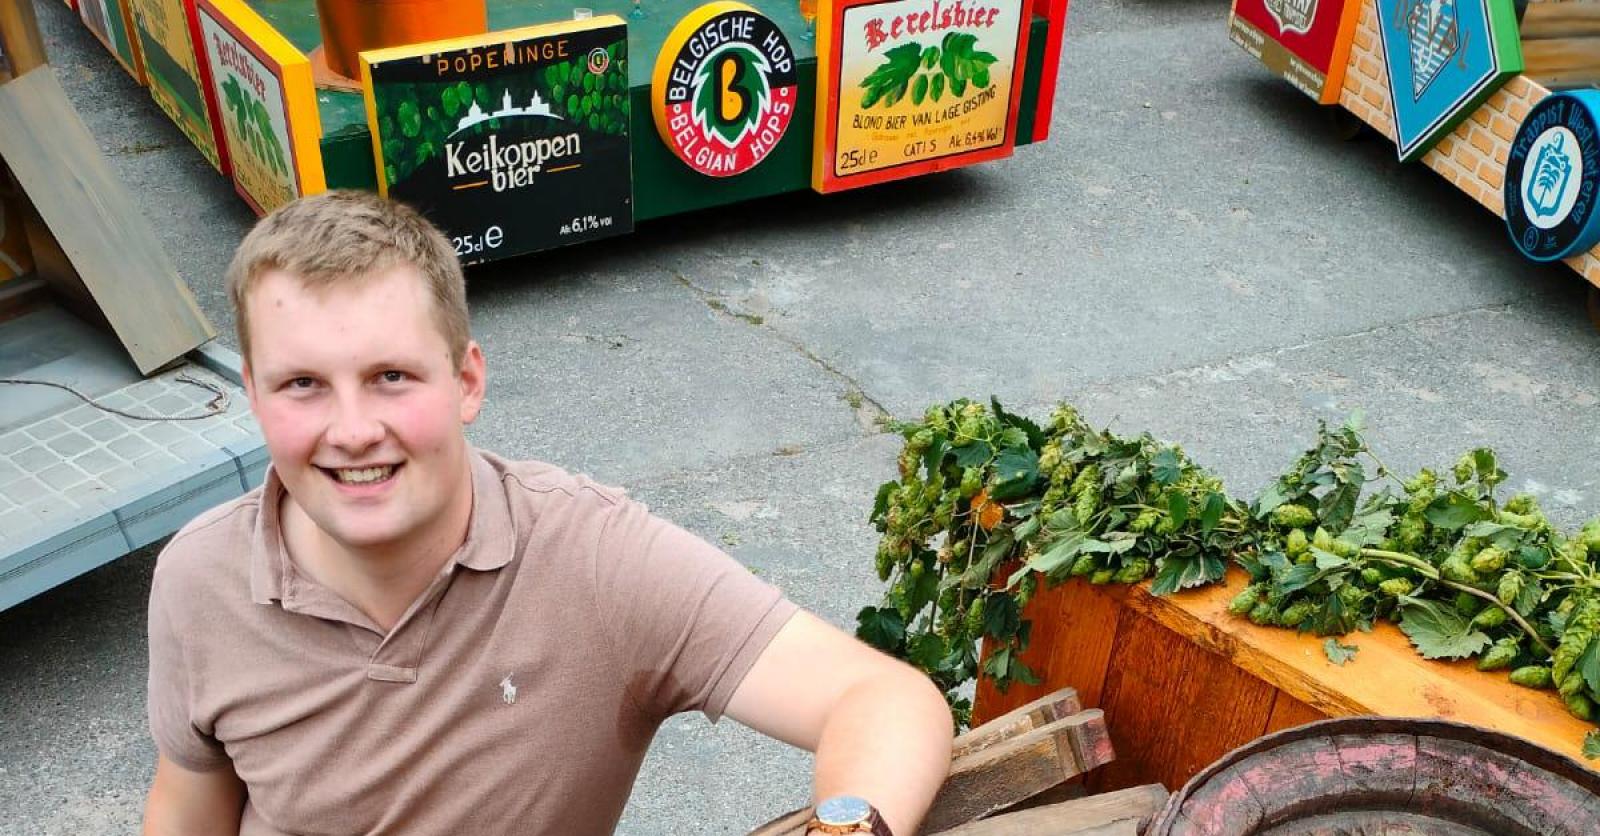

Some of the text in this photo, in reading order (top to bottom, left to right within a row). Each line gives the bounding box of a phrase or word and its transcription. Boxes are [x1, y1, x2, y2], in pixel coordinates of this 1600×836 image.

[669, 17, 791, 100] BELGISCHE HOP
[852, 114, 882, 129] BLOND
[885, 115, 906, 130] BIER
[912, 112, 932, 126] VAN
[935, 103, 960, 123] LAGE
[963, 84, 997, 114] GISTING
[444, 132, 581, 177] Keikoppen
[671, 101, 790, 171] BELGIAN HOPS
[869, 150, 878, 163] e
[492, 160, 541, 192] bier
[484, 225, 504, 249] e
